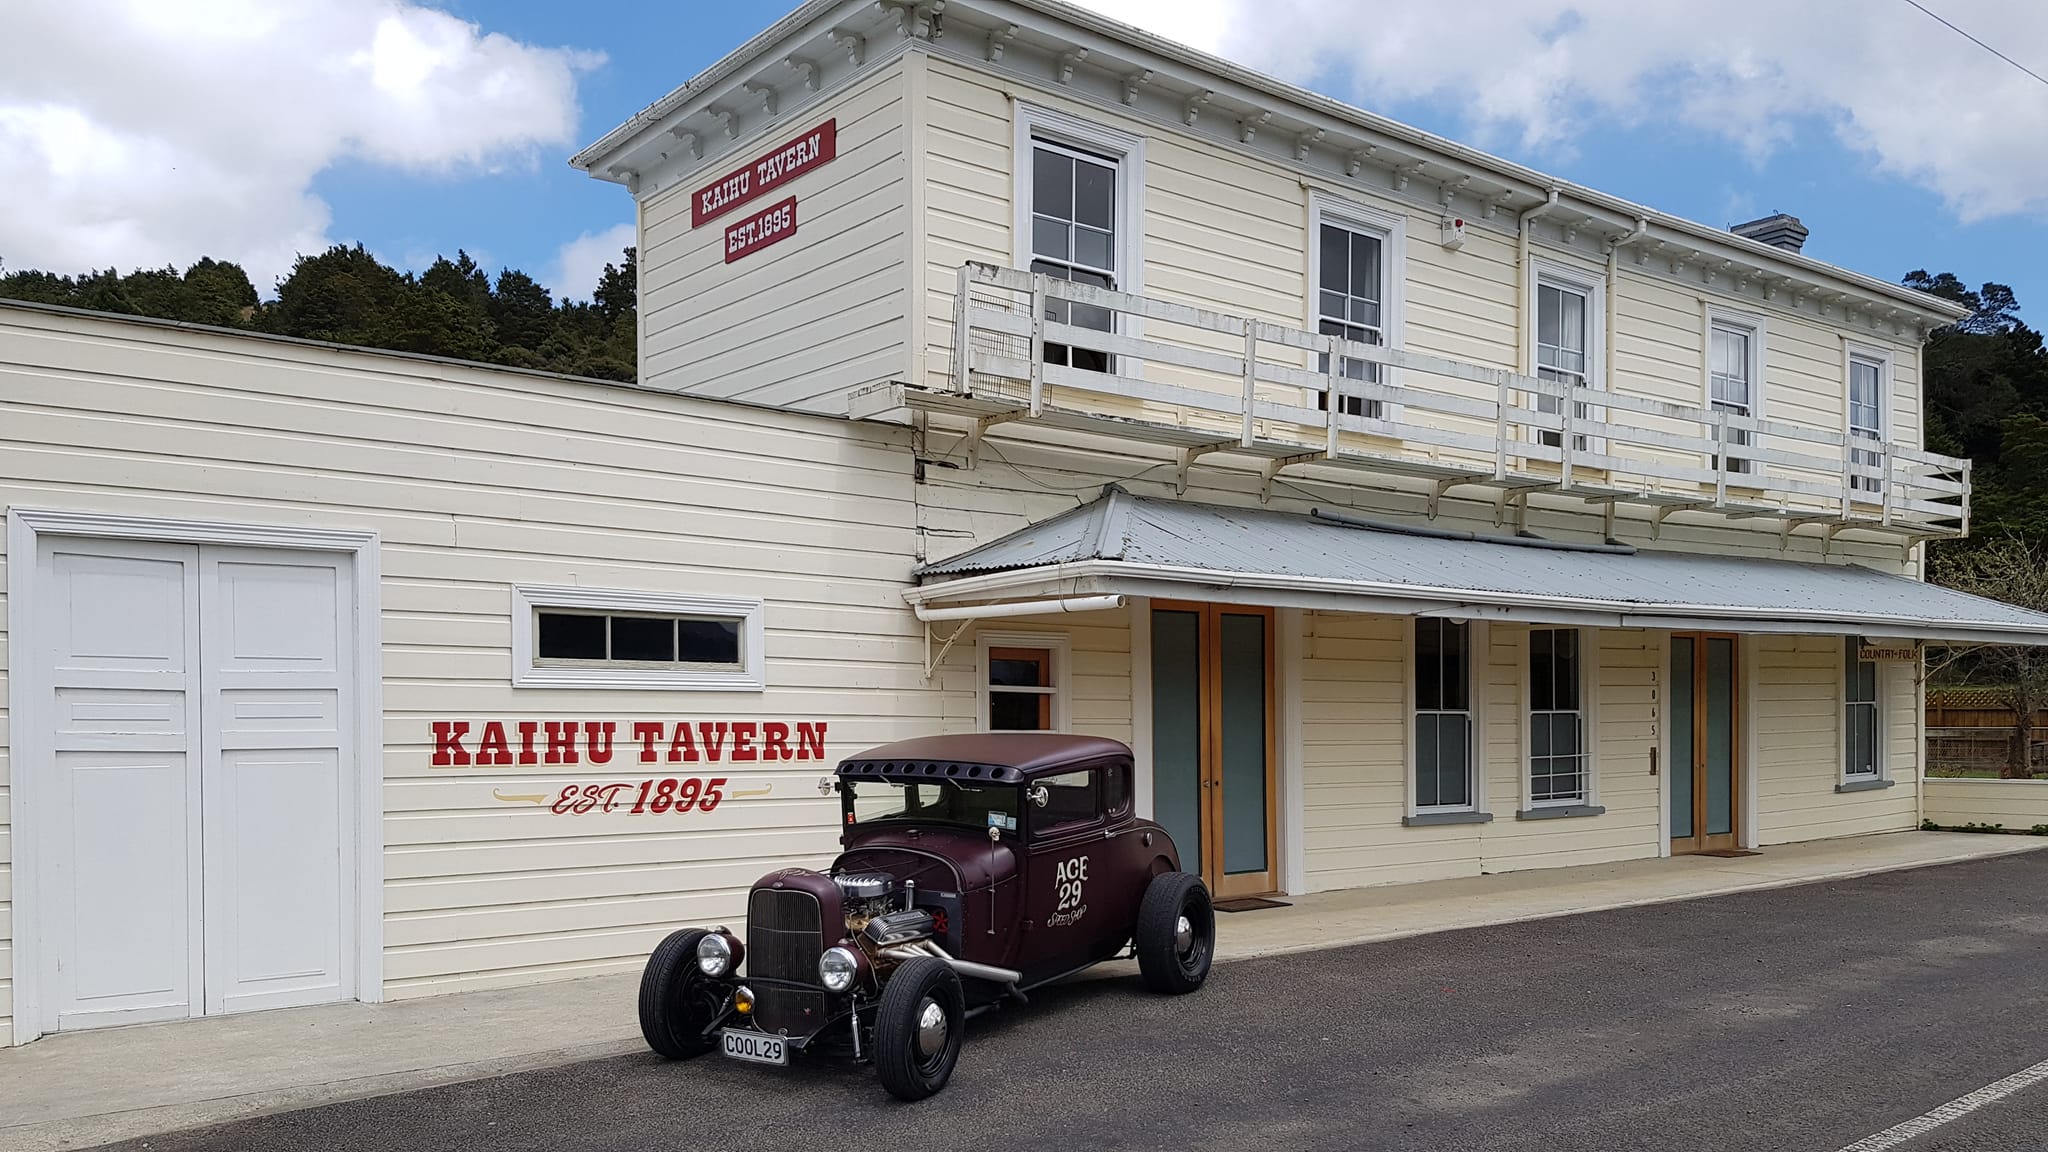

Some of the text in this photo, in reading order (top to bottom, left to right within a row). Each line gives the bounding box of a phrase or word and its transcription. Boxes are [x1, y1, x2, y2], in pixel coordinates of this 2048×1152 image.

[702, 133, 821, 215] KAIHU TAVERN
[728, 204, 791, 254] EST.1895
[431, 721, 828, 766] KAIHU TAVERN
[630, 777, 729, 814] 1895
[1055, 855, 1089, 890] ACE
[1057, 880, 1082, 911] 29
[726, 1035, 782, 1059] COOL29
